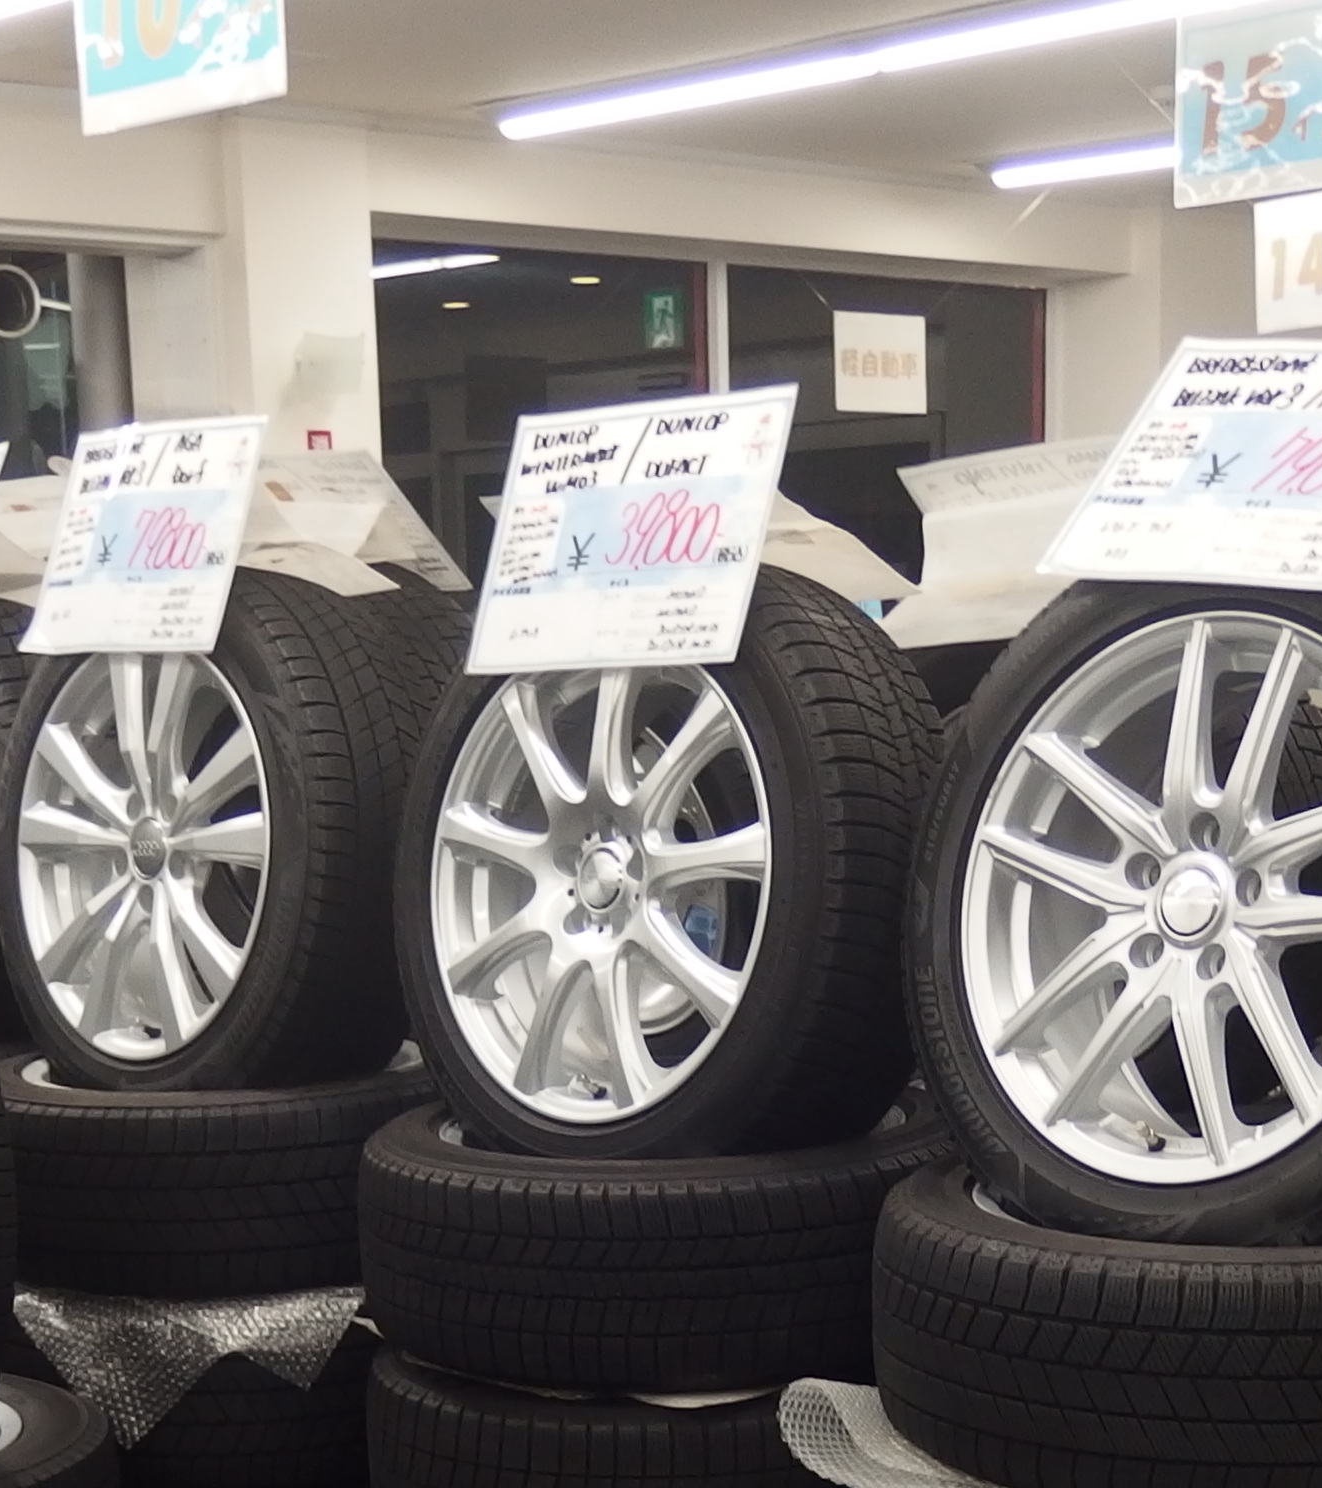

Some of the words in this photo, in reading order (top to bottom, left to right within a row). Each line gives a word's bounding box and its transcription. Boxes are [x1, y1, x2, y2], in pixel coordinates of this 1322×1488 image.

[840, 348, 918, 379] 軽自動車
[656, 411, 729, 436] DUNLOP
[533, 425, 599, 451] DUNLOP
